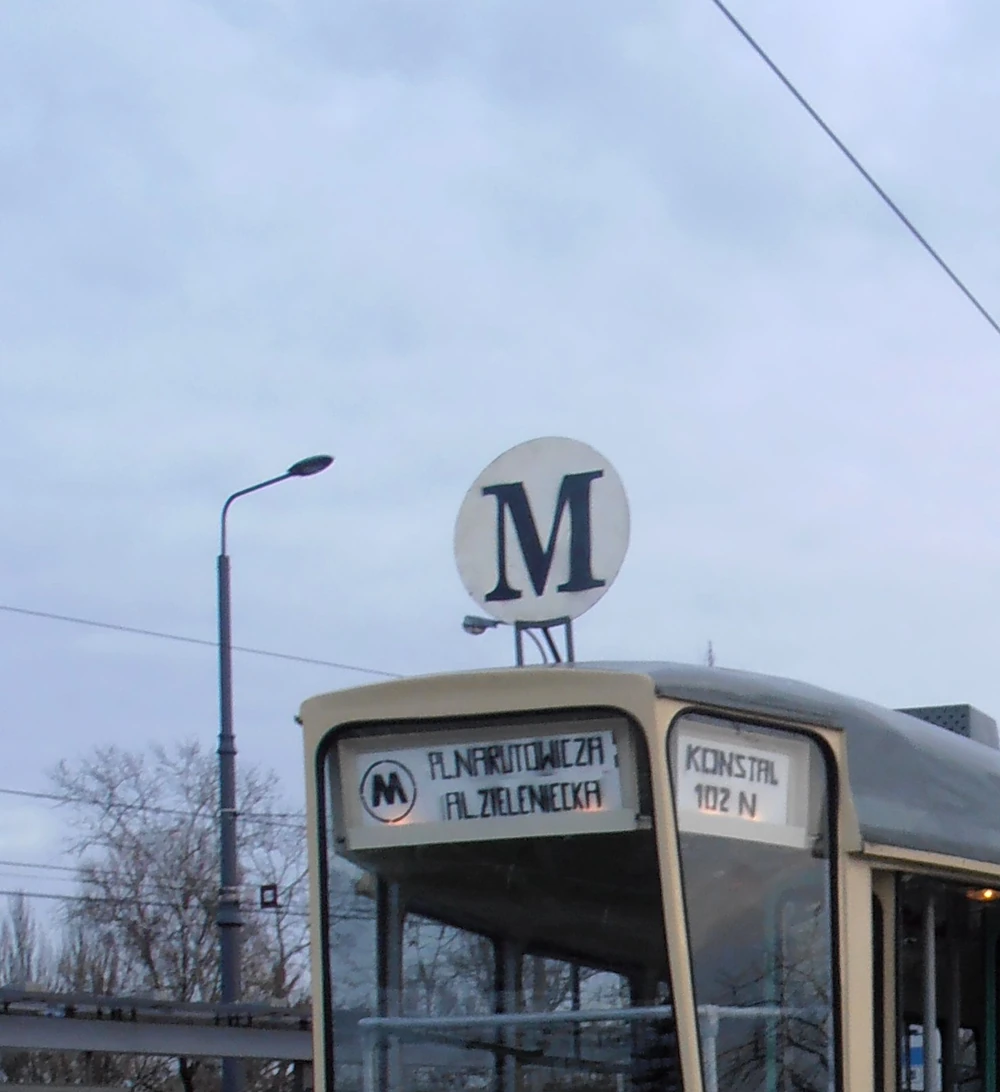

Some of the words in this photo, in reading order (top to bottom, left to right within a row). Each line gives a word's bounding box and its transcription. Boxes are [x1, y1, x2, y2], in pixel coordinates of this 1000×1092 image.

[482, 469, 606, 602] M
[686, 743, 779, 786] KONSTAL
[372, 771, 409, 807] M
[694, 783, 731, 812] 102
[738, 790, 757, 818] N
